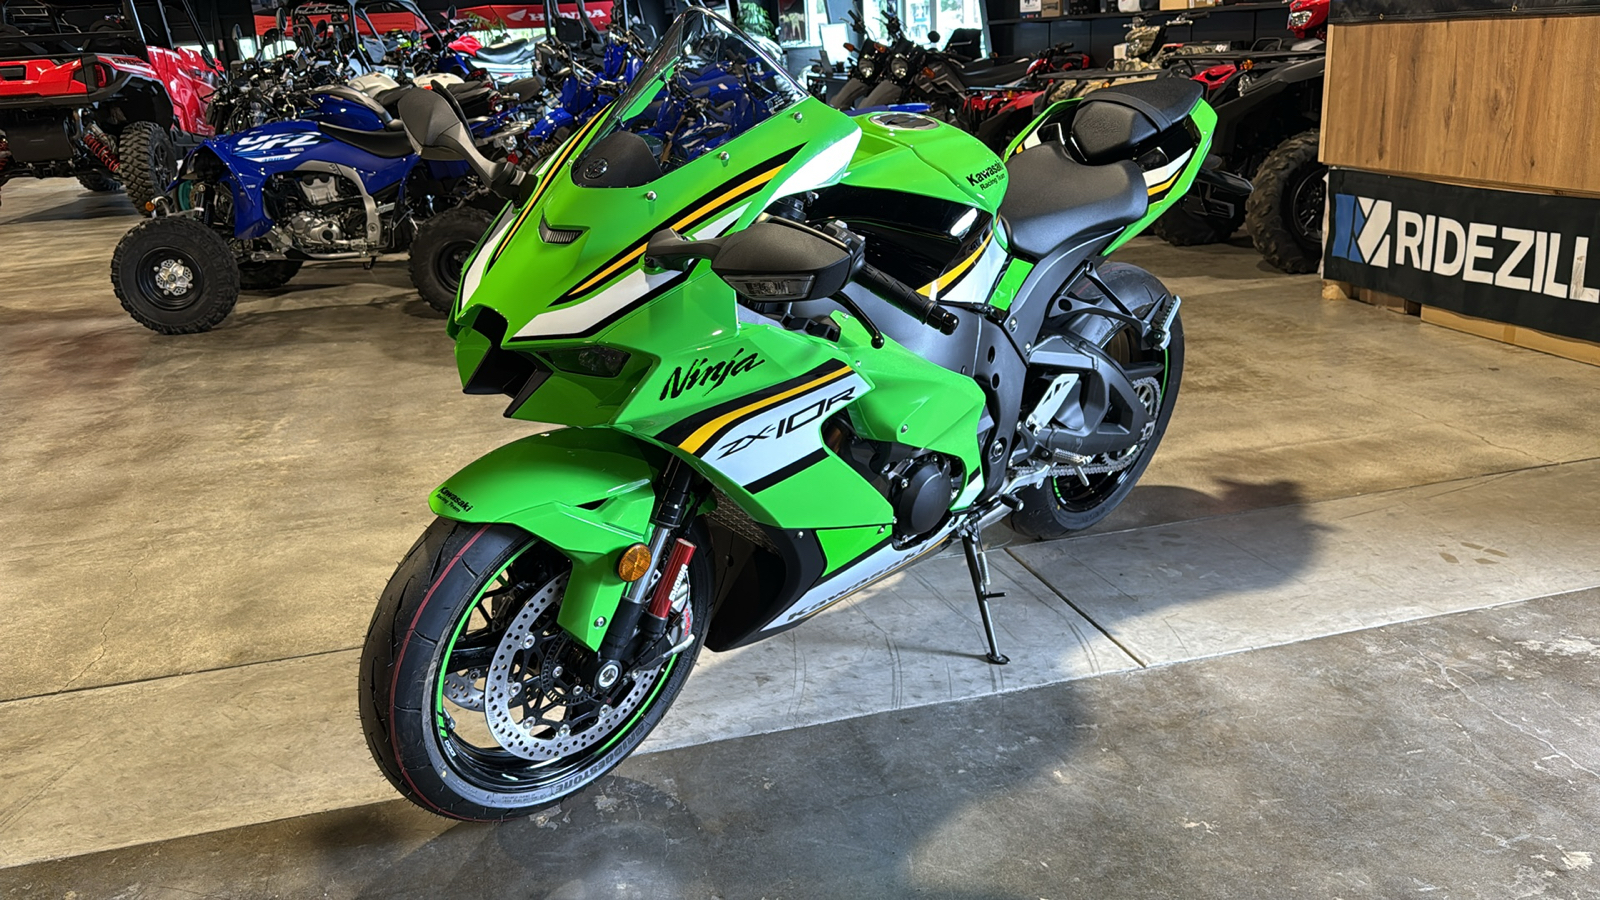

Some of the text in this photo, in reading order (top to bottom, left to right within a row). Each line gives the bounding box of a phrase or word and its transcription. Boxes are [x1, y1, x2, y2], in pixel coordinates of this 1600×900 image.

[1395, 210, 1600, 304] RIDEZILL
[659, 347, 765, 401] Ninja
[716, 386, 856, 461] ZX-10R
[438, 486, 474, 512] Kawasaki
[668, 563, 689, 602] SHOWA
[554, 725, 646, 794] BRIDGESTONE
